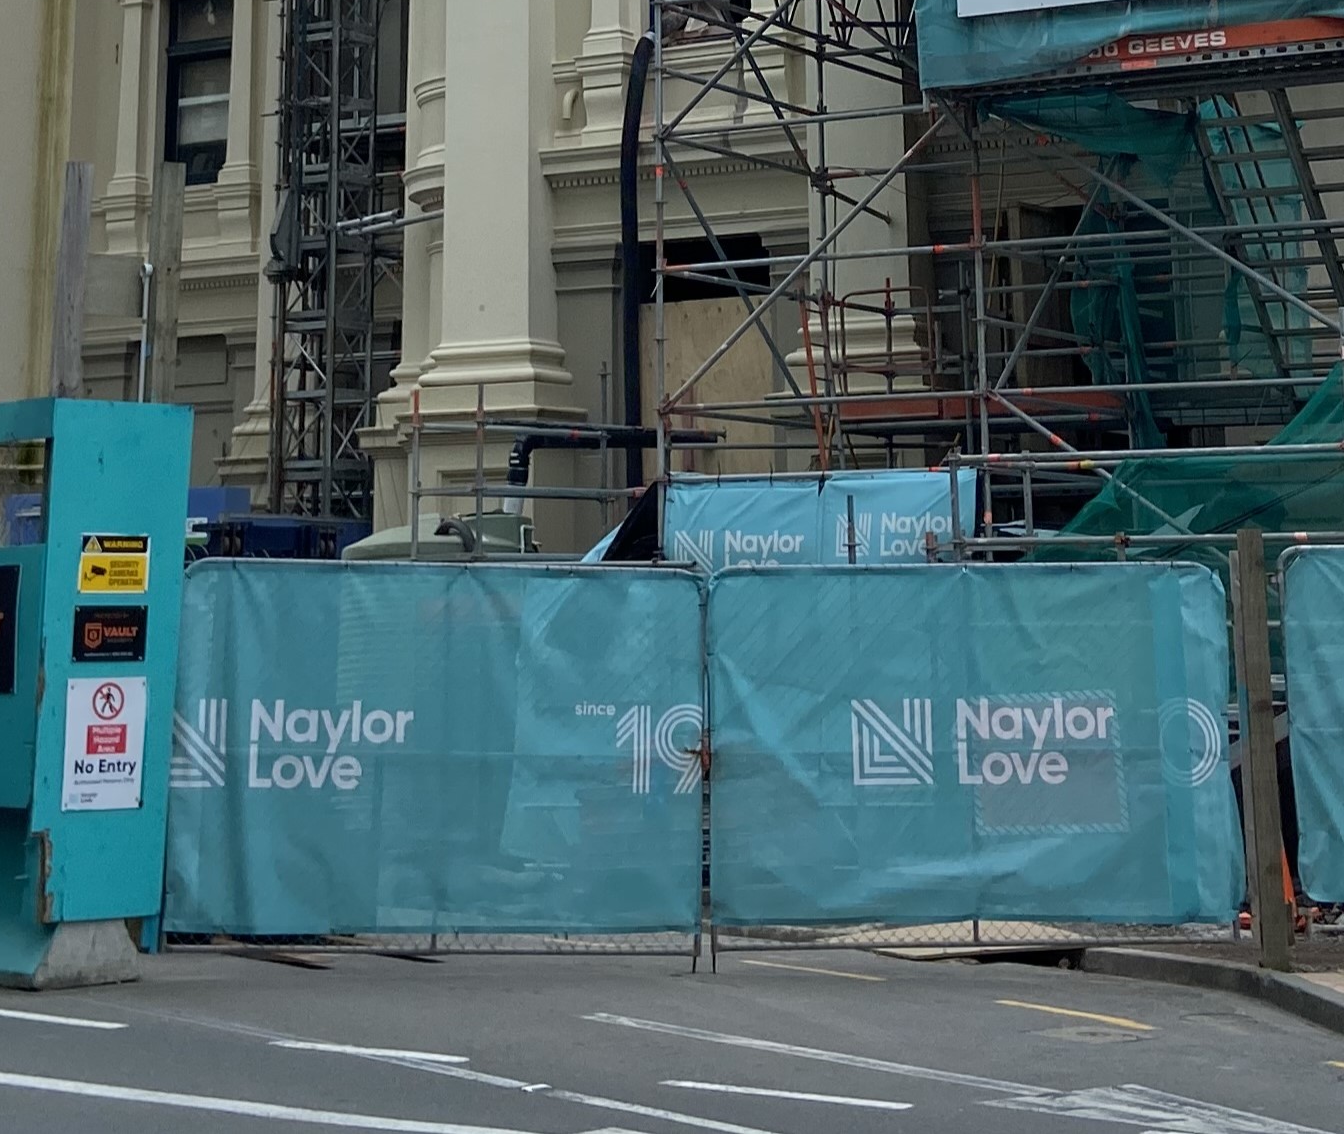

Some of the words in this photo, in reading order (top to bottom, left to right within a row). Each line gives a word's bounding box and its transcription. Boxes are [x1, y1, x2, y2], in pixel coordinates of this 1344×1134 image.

[1128, 30, 1227, 55] GEEVES
[103, 540, 144, 549] WARNING
[724, 529, 805, 557] Naylor
[103, 627, 138, 638] VAULT
[250, 698, 415, 758] Naylor
[957, 697, 1114, 751] Naylor
[574, 701, 616, 718] since
[615, 703, 705, 795] 19
[74, 759, 95, 775] No
[98, 759, 137, 777] Entry
[248, 743, 363, 791] Love
[957, 746, 1070, 786] Love
